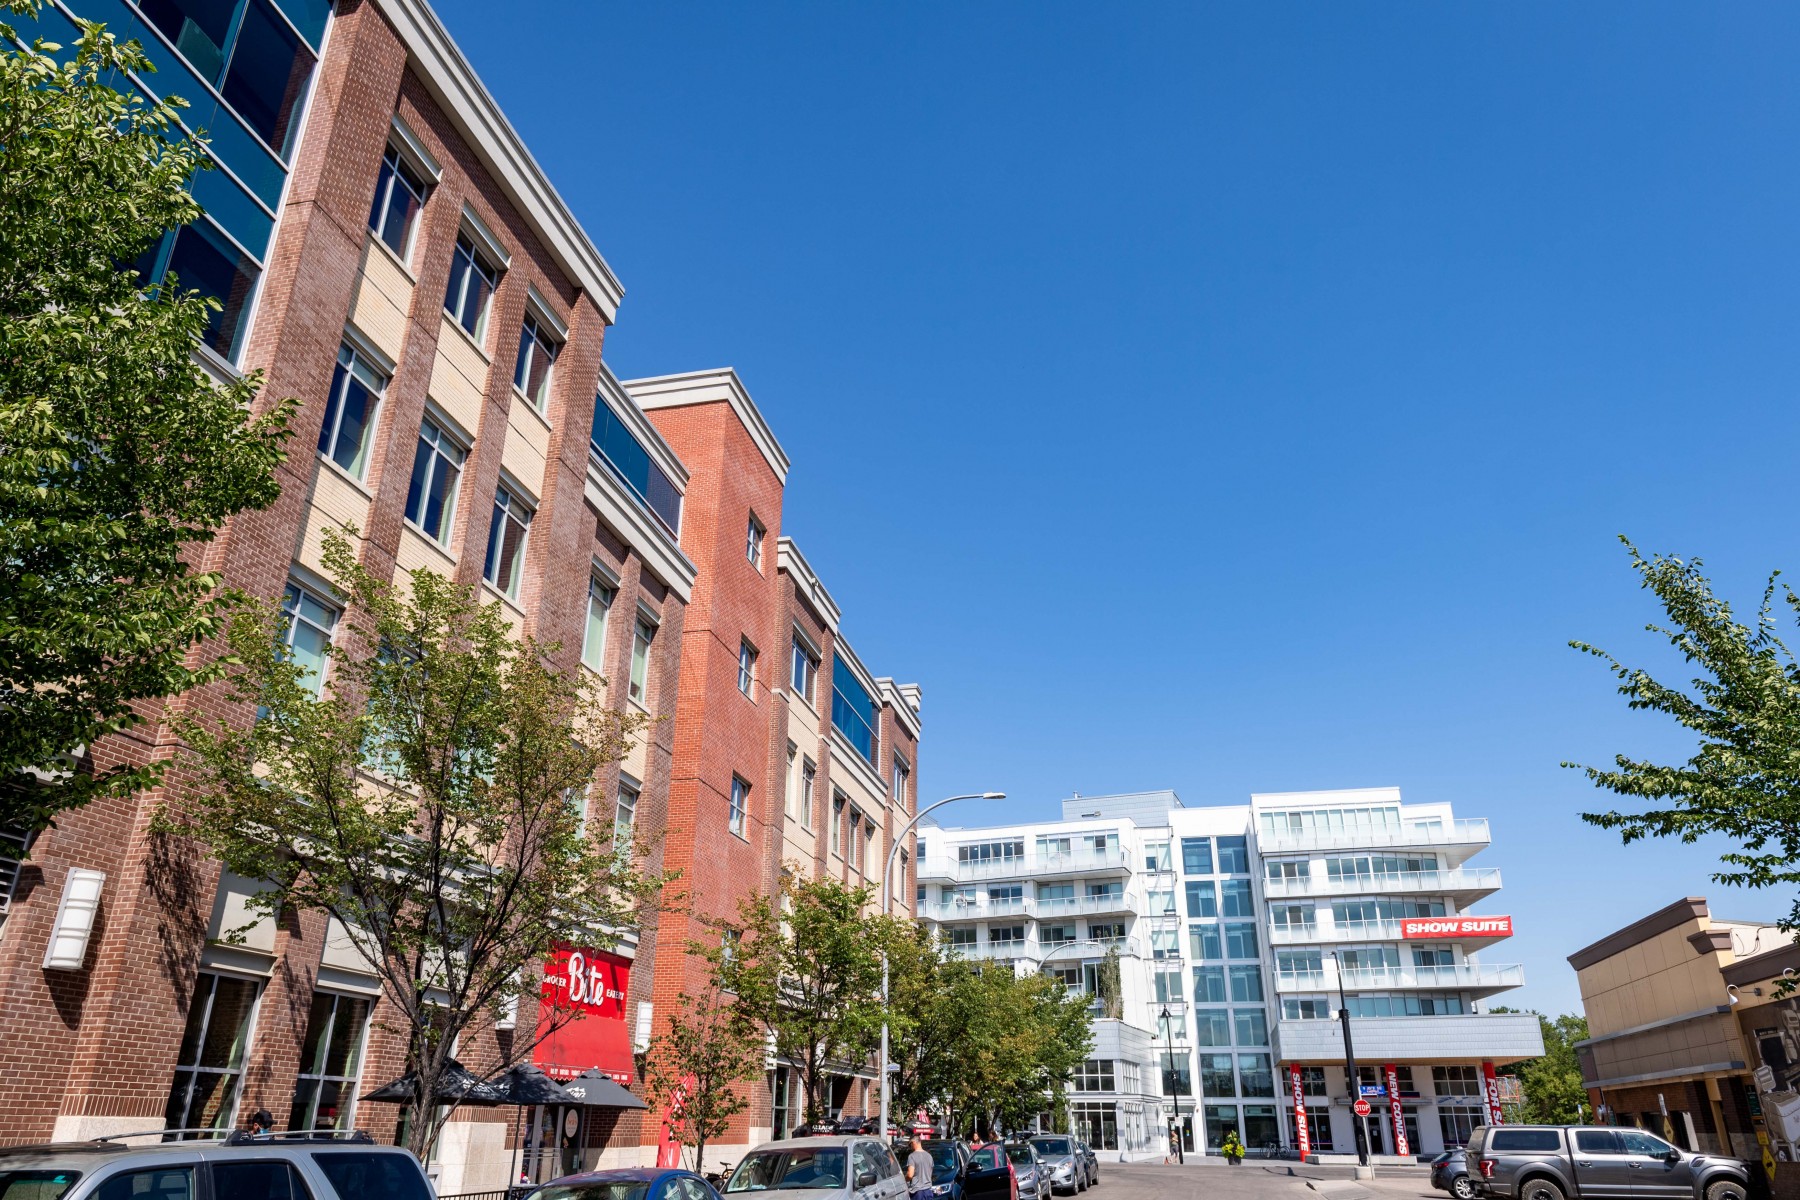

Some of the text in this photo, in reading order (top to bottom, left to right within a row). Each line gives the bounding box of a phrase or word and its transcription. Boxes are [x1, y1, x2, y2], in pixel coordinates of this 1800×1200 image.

[1406, 920, 1508, 933] SHOW SUITE
[568, 952, 604, 1006] Bite
[1293, 1072, 1309, 1152] SHOW SUITE
[1355, 1104, 1370, 1112] STOP
[1388, 1071, 1407, 1154] NEW CONDOS
[1487, 1078, 1500, 1107] FOR
